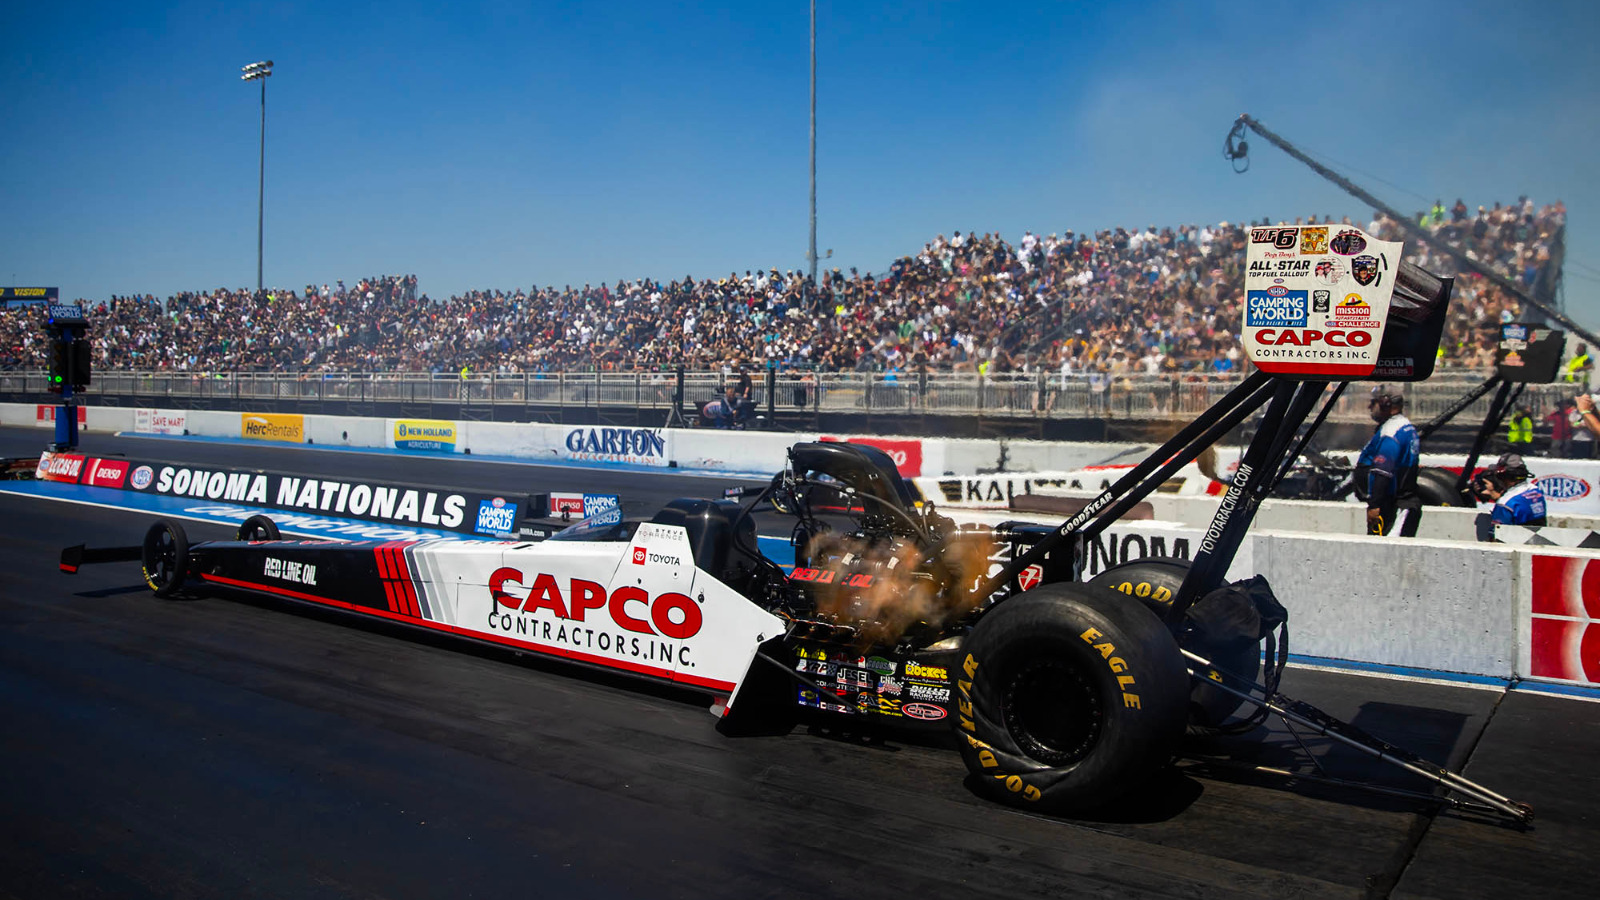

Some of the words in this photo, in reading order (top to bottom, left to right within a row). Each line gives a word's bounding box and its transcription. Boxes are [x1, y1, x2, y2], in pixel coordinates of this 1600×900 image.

[1250, 261, 1271, 270] ALL
[1278, 260, 1310, 270] STAR
[14, 288, 46, 296] VISION
[1250, 297, 1304, 307] CAMPING
[1251, 307, 1304, 320] WORLD
[1255, 329, 1372, 346] CAPCO
[1256, 350, 1342, 358] CONTRACTORS
[1347, 351, 1370, 359] INC.
[152, 416, 167, 426] SAVE
[168, 417, 185, 426] MART
[408, 427, 422, 435] NEW
[423, 428, 453, 437] HOLLAND
[566, 428, 665, 457] GARTON
[48, 456, 69, 475] LUCAS
[67, 460, 82, 476] OIL
[97, 468, 121, 479] DENSO
[156, 466, 268, 503] SONOMA
[276, 477, 466, 528] NATIONALS
[584, 496, 617, 507] CAMPING
[480, 506, 514, 520] CAMPING
[1061, 492, 1113, 536] GOODYEAR
[1199, 463, 1254, 555] TOYOTARACING.COM
[478, 515, 511, 530] WORLD
[639, 530, 683, 540] TORRENCE
[649, 553, 681, 566] TOYOTA
[264, 556, 281, 578] RED
[282, 560, 302, 582] LINE
[302, 564, 317, 586] OIL
[789, 567, 818, 581] RED
[849, 574, 873, 588] OIL
[489, 567, 703, 639] CAPCO
[1080, 627, 1141, 710] EAGLE
[837, 668, 872, 685] JESEL
